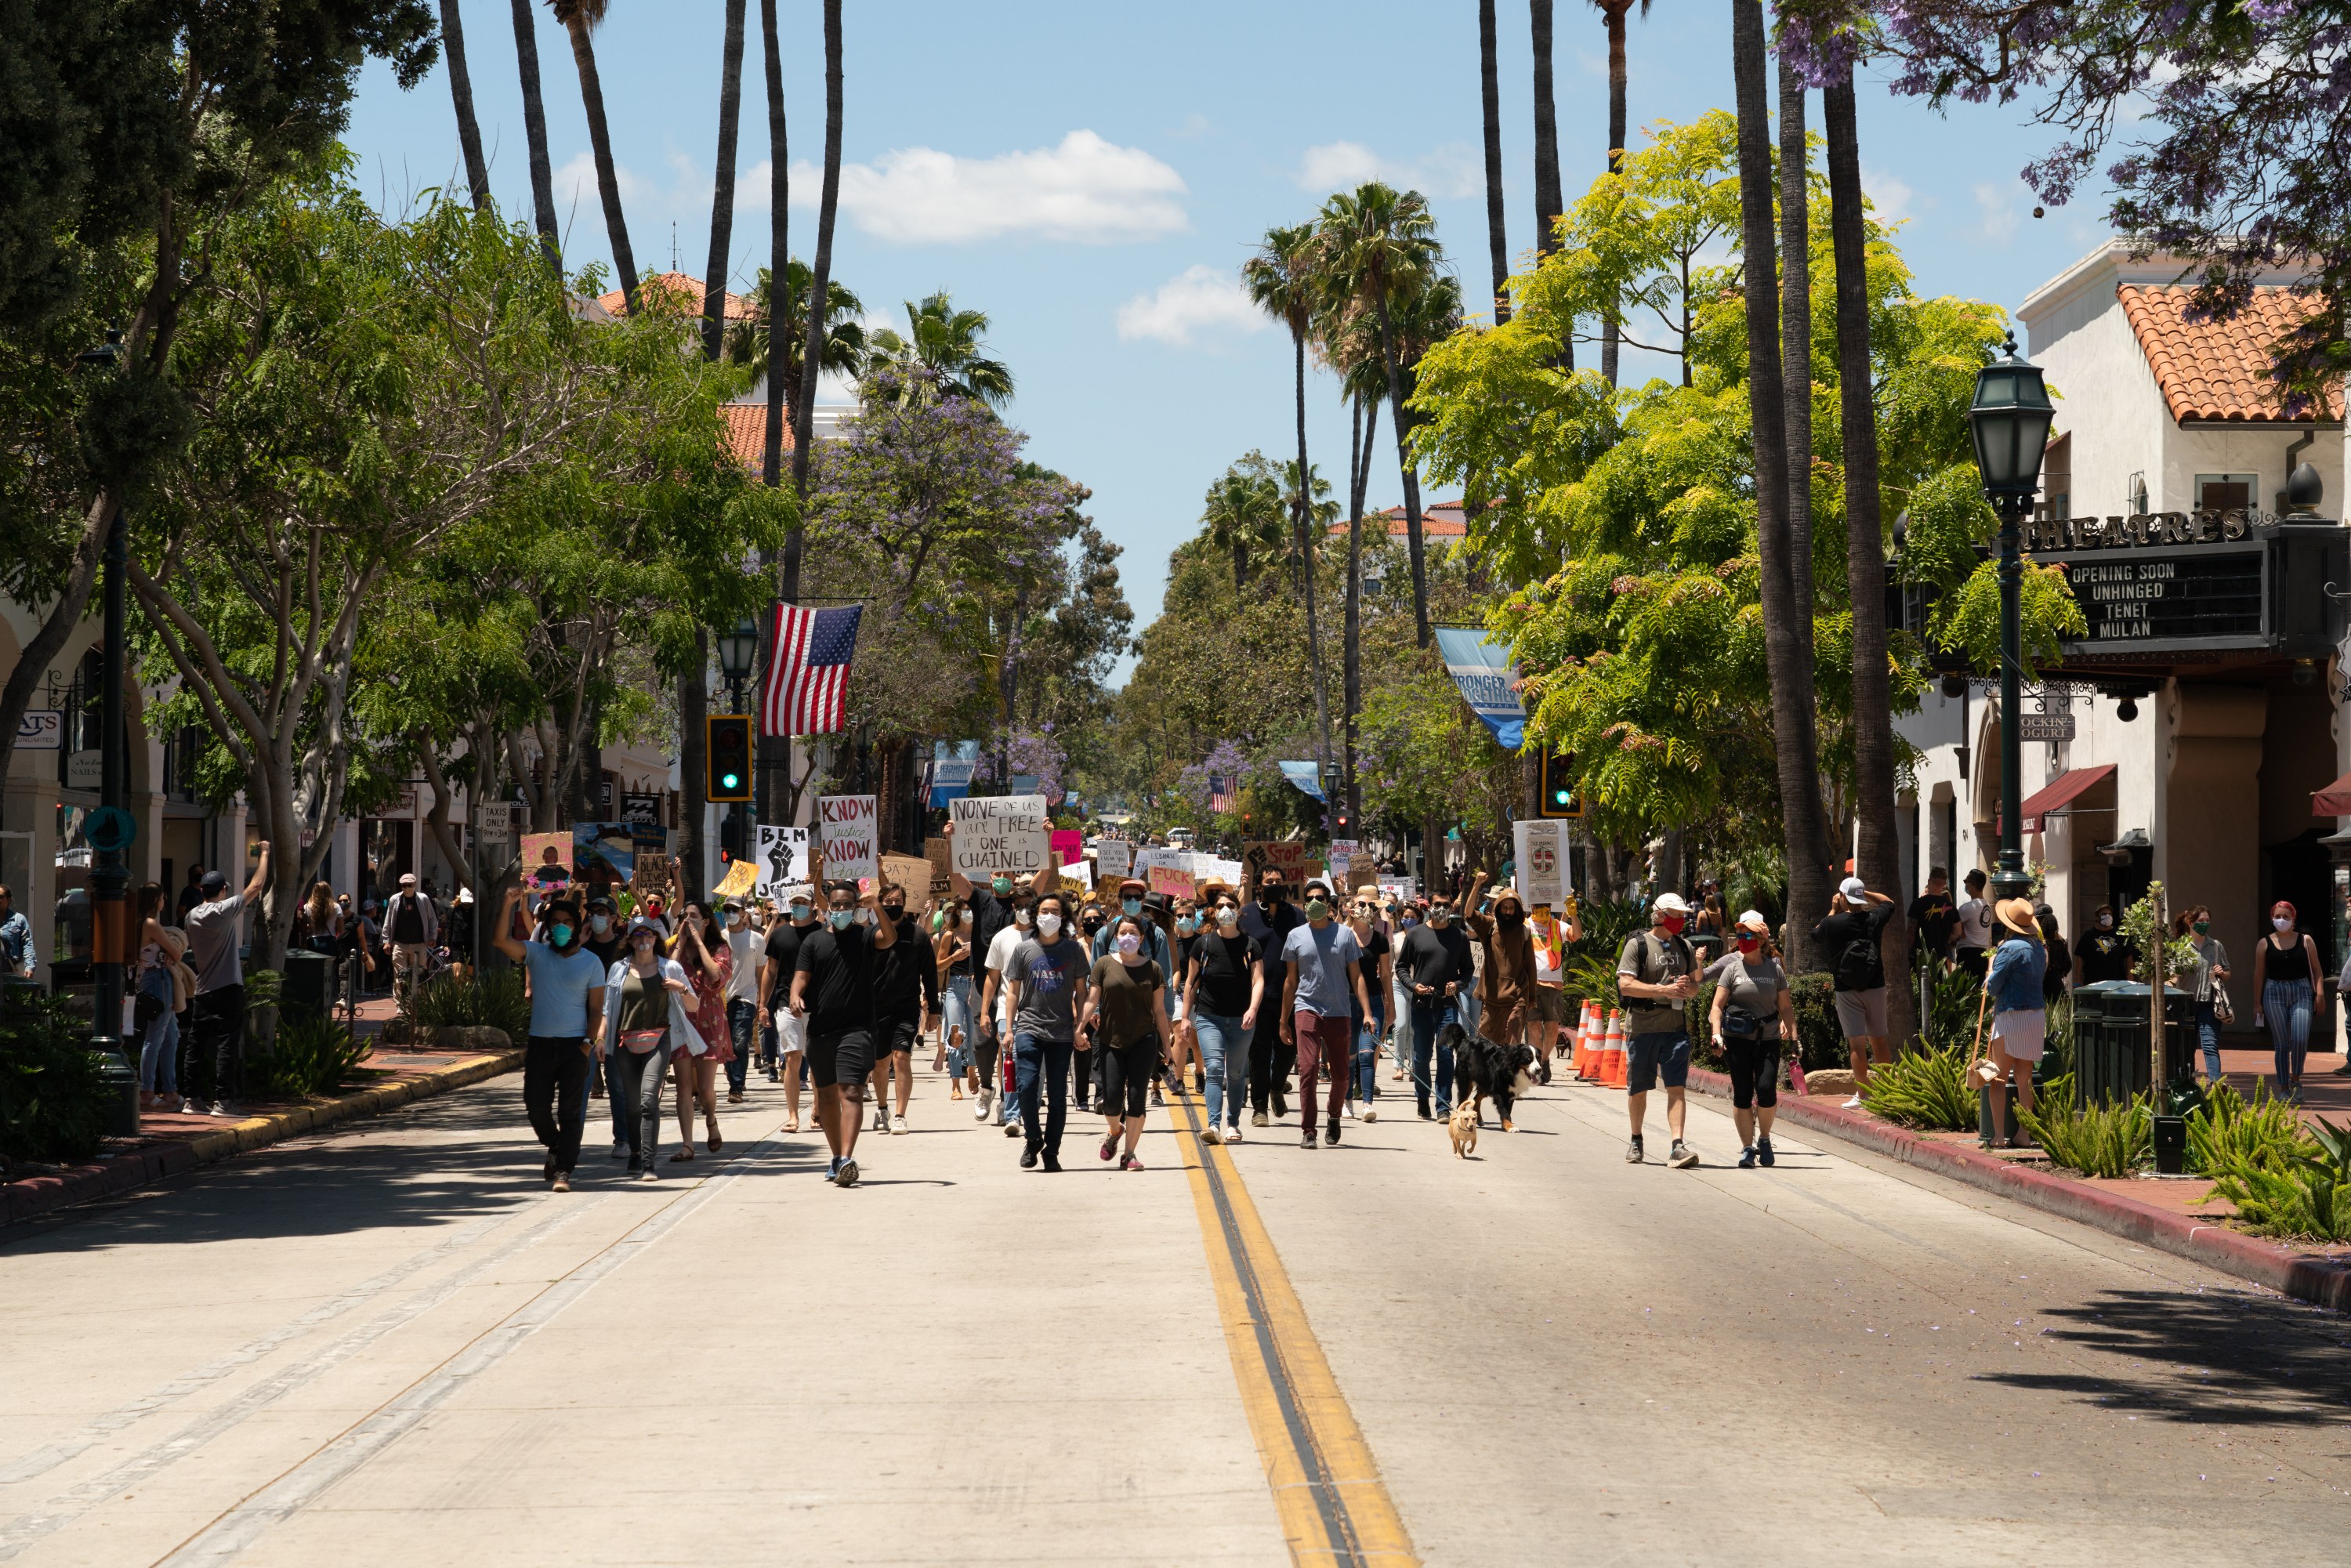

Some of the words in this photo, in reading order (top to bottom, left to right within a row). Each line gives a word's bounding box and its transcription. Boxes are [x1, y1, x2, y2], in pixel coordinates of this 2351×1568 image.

[2073, 566, 2132, 583] OPENING
[2139, 563, 2175, 580] SOON
[2092, 582, 2163, 600] UNHINGED
[2105, 603, 2149, 619] TENET
[2100, 621, 2150, 638] MULAN
[1452, 675, 1505, 691] TRONGER
[20, 716, 56, 729] ATS
[2021, 717, 2067, 727] OCKIN'
[2021, 728, 2067, 738] OGURT
[486, 807, 507, 817] TAXIS
[821, 798, 874, 822] KNOW
[954, 800, 998, 821] NONE
[1004, 802, 1018, 811] OF
[1023, 802, 1040, 811] US
[486, 818, 505, 827] ONLY
[621, 814, 657, 826] Billabong
[965, 820, 988, 835] are
[998, 815, 1040, 835] FREE
[483, 829, 493, 838] 9PM
[498, 829, 508, 838] 3AM
[761, 827, 806, 846] BLM
[827, 824, 867, 838] Justice
[822, 839, 871, 862] KNOW
[980, 837, 1009, 850] ONE
[958, 850, 1040, 868] CHAINED
[1267, 843, 1302, 864] STOP
[640, 855, 668, 872] BLACK
[830, 862, 873, 878] Peace
[884, 864, 911, 875] SAY
[640, 873, 668, 882] LIVES
[890, 878, 915, 886] EIR
[1154, 866, 1190, 885] FUCK
[930, 882, 948, 892] BLM
[1032, 970, 1064, 980] NASA
